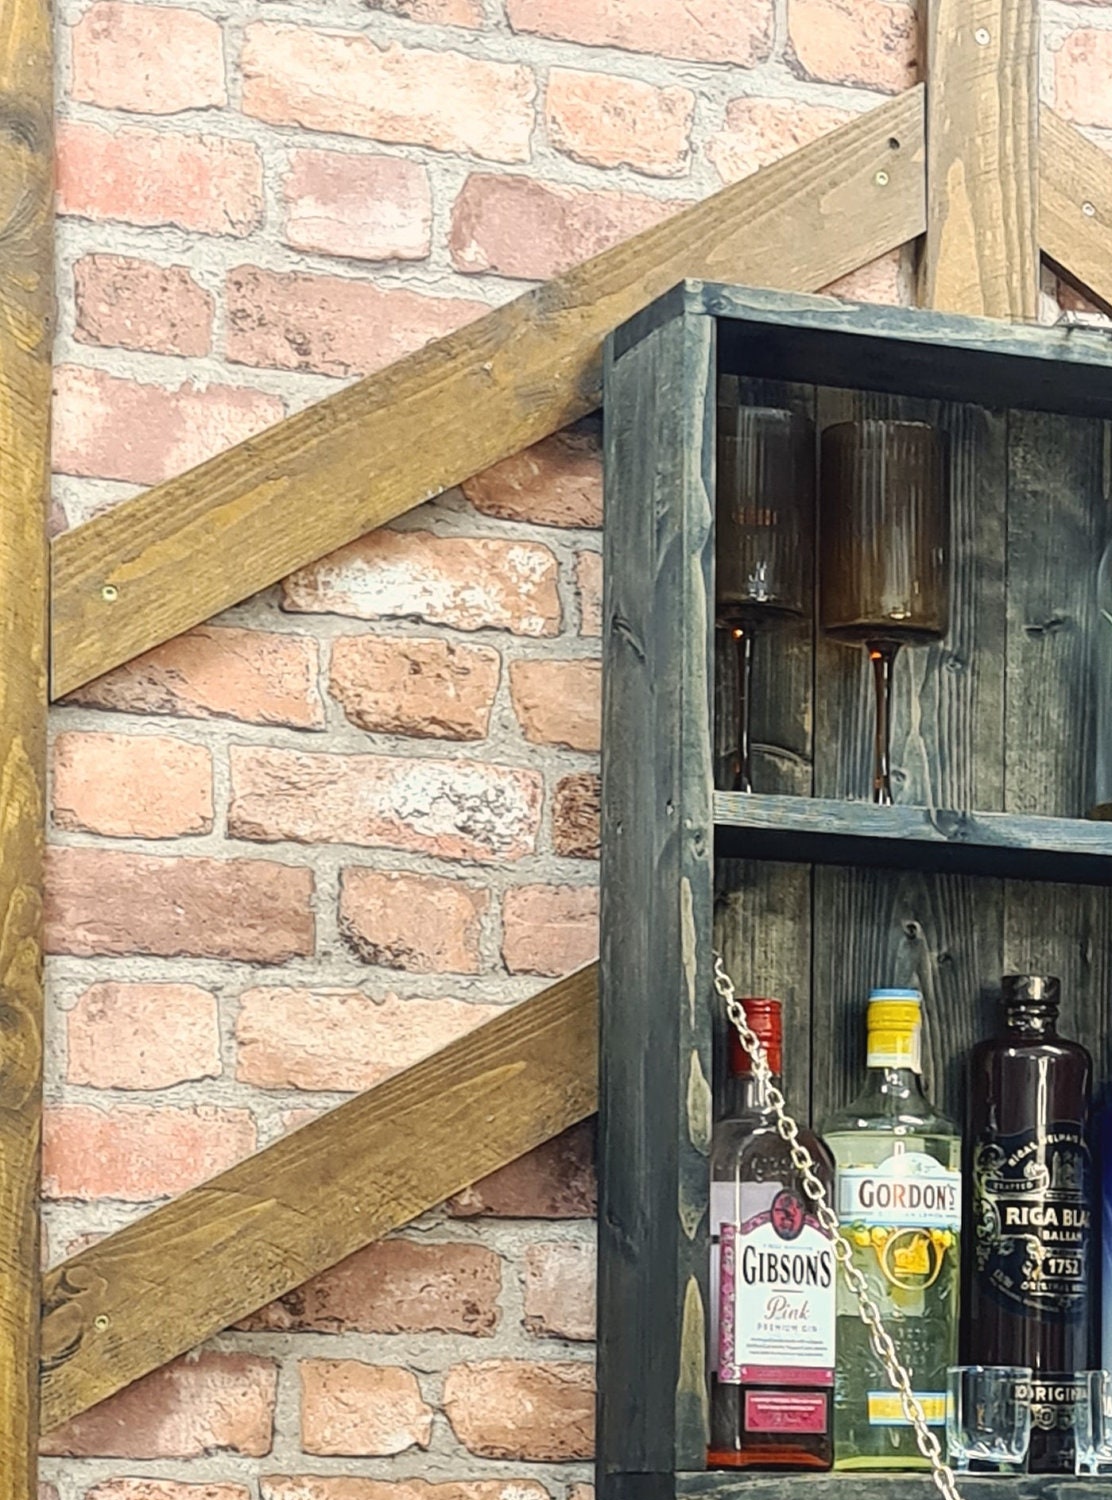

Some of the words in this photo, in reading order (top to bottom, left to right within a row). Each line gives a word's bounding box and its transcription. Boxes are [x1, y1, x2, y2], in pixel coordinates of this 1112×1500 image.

[858, 1179, 958, 1210] GORDON'S
[1005, 1206, 1059, 1228] RIGA
[742, 1245, 832, 1289] GIBSON'S
[1047, 1258, 1080, 1275] 1752
[764, 1295, 811, 1321] Pink
